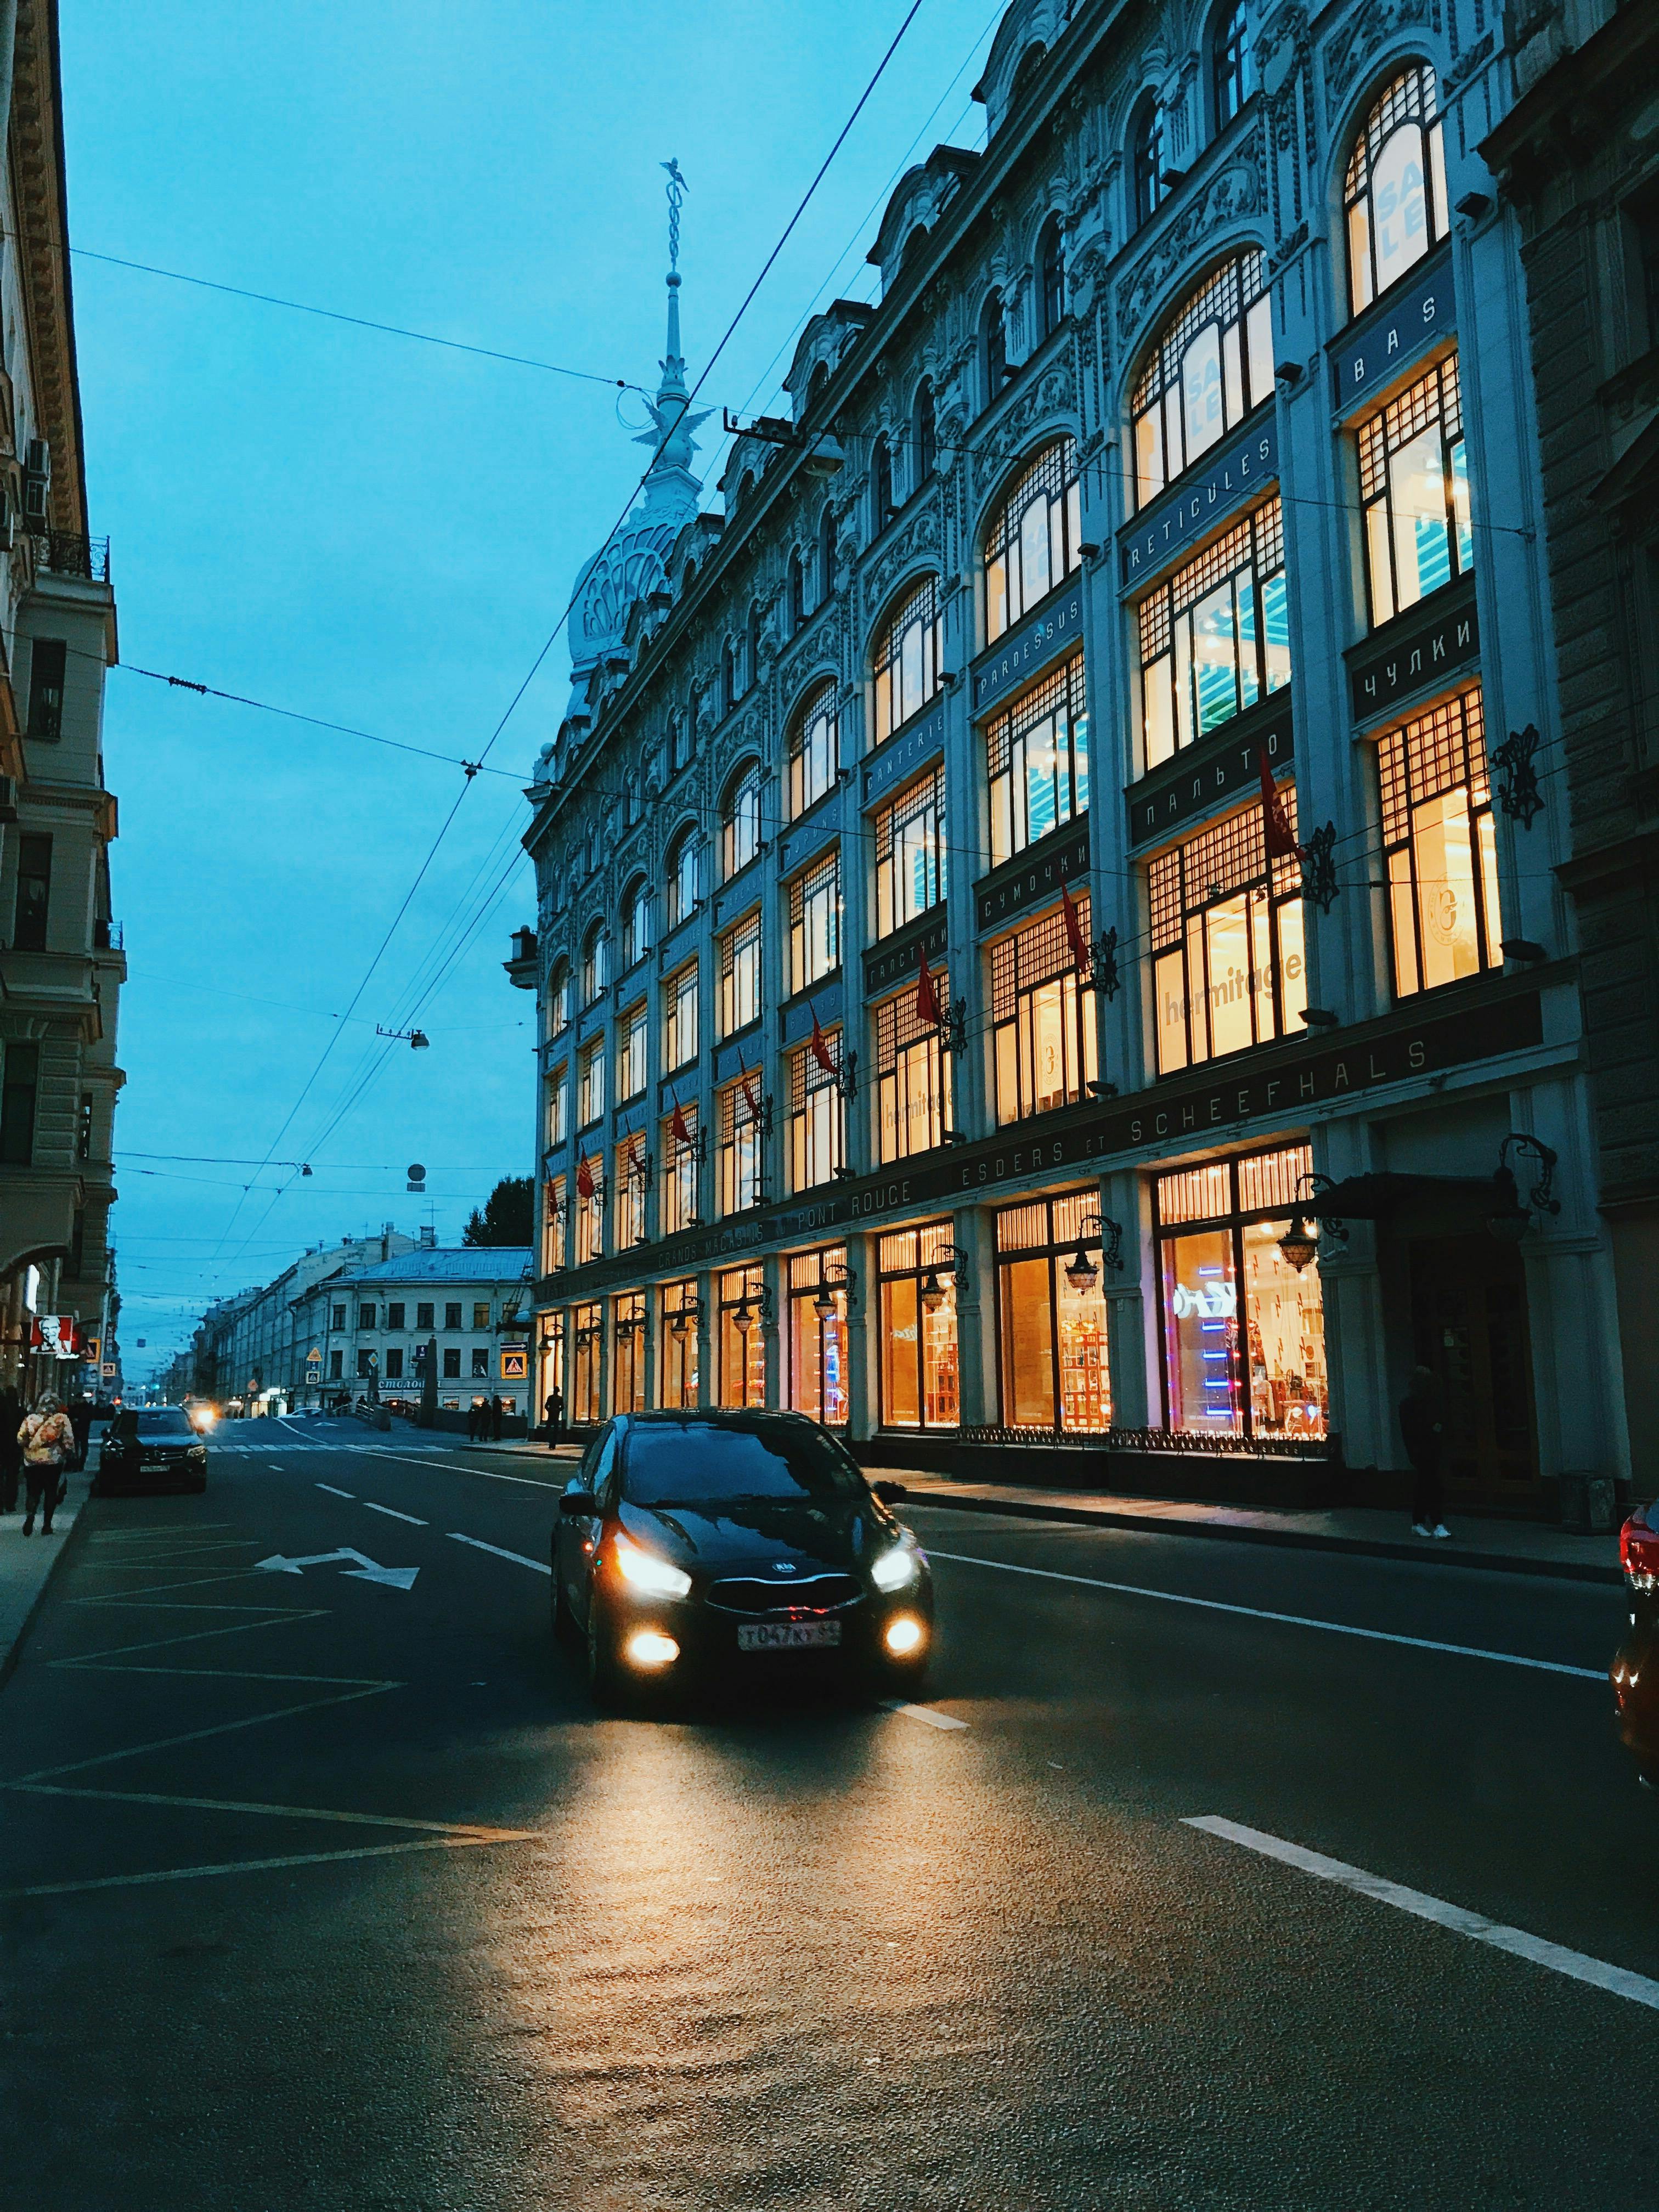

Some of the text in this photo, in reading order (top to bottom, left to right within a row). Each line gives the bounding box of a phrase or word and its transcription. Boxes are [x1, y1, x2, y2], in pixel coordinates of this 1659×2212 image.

[1354, 297, 1435, 382] BAS
[1132, 439, 1269, 568] RETICULES
[980, 601, 1077, 695] PARDESSUS
[1364, 619, 1470, 697] ЧУЛКИ
[1147, 733, 1277, 826] ПАЛЬТО
[985, 845, 1085, 917] СУМОЧКИ
[799, 1203, 836, 1229] PONT
[852, 1181, 910, 1216] ROUGE
[962, 1143, 1062, 1186] ESDERS
[1086, 1136, 1104, 1153] ET
[1131, 1041, 1425, 1141] SCHEEFHALS
